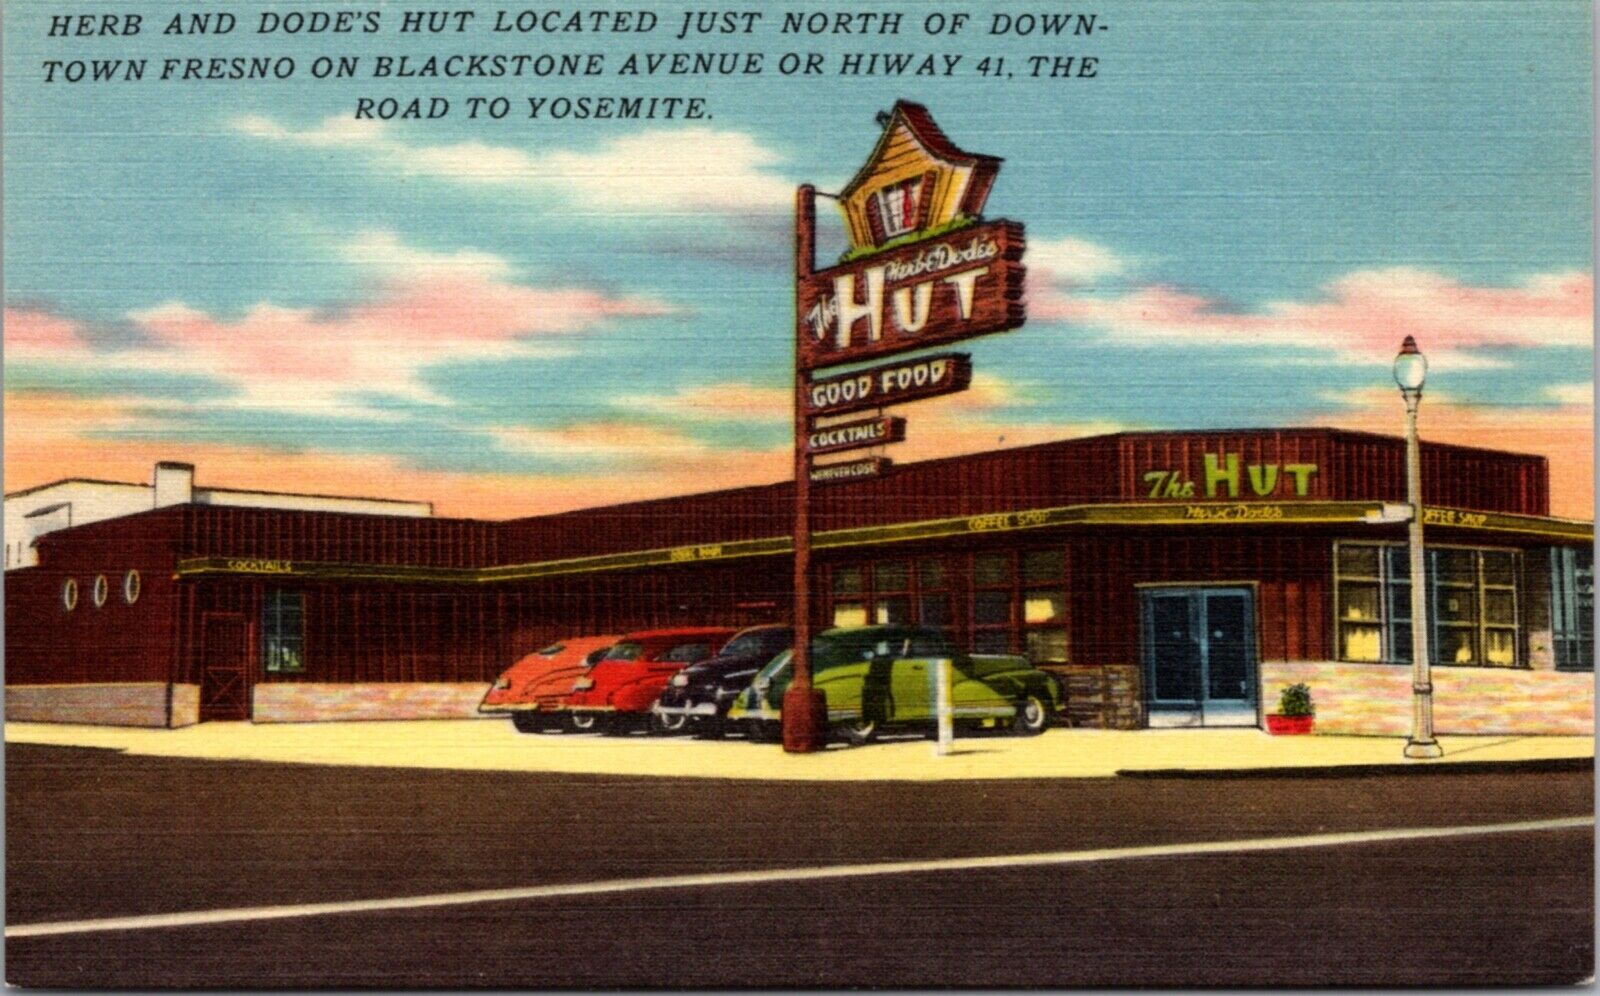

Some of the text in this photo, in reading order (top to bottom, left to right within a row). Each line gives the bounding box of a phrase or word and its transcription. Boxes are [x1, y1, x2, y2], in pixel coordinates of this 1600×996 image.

[807, 265, 990, 349] The HUT
[812, 359, 947, 408] GOOD FOOD
[809, 422, 885, 447] COCKTAILS
[1144, 453, 1318, 498] The HUT
[227, 559, 292, 573] COCKTAILS
